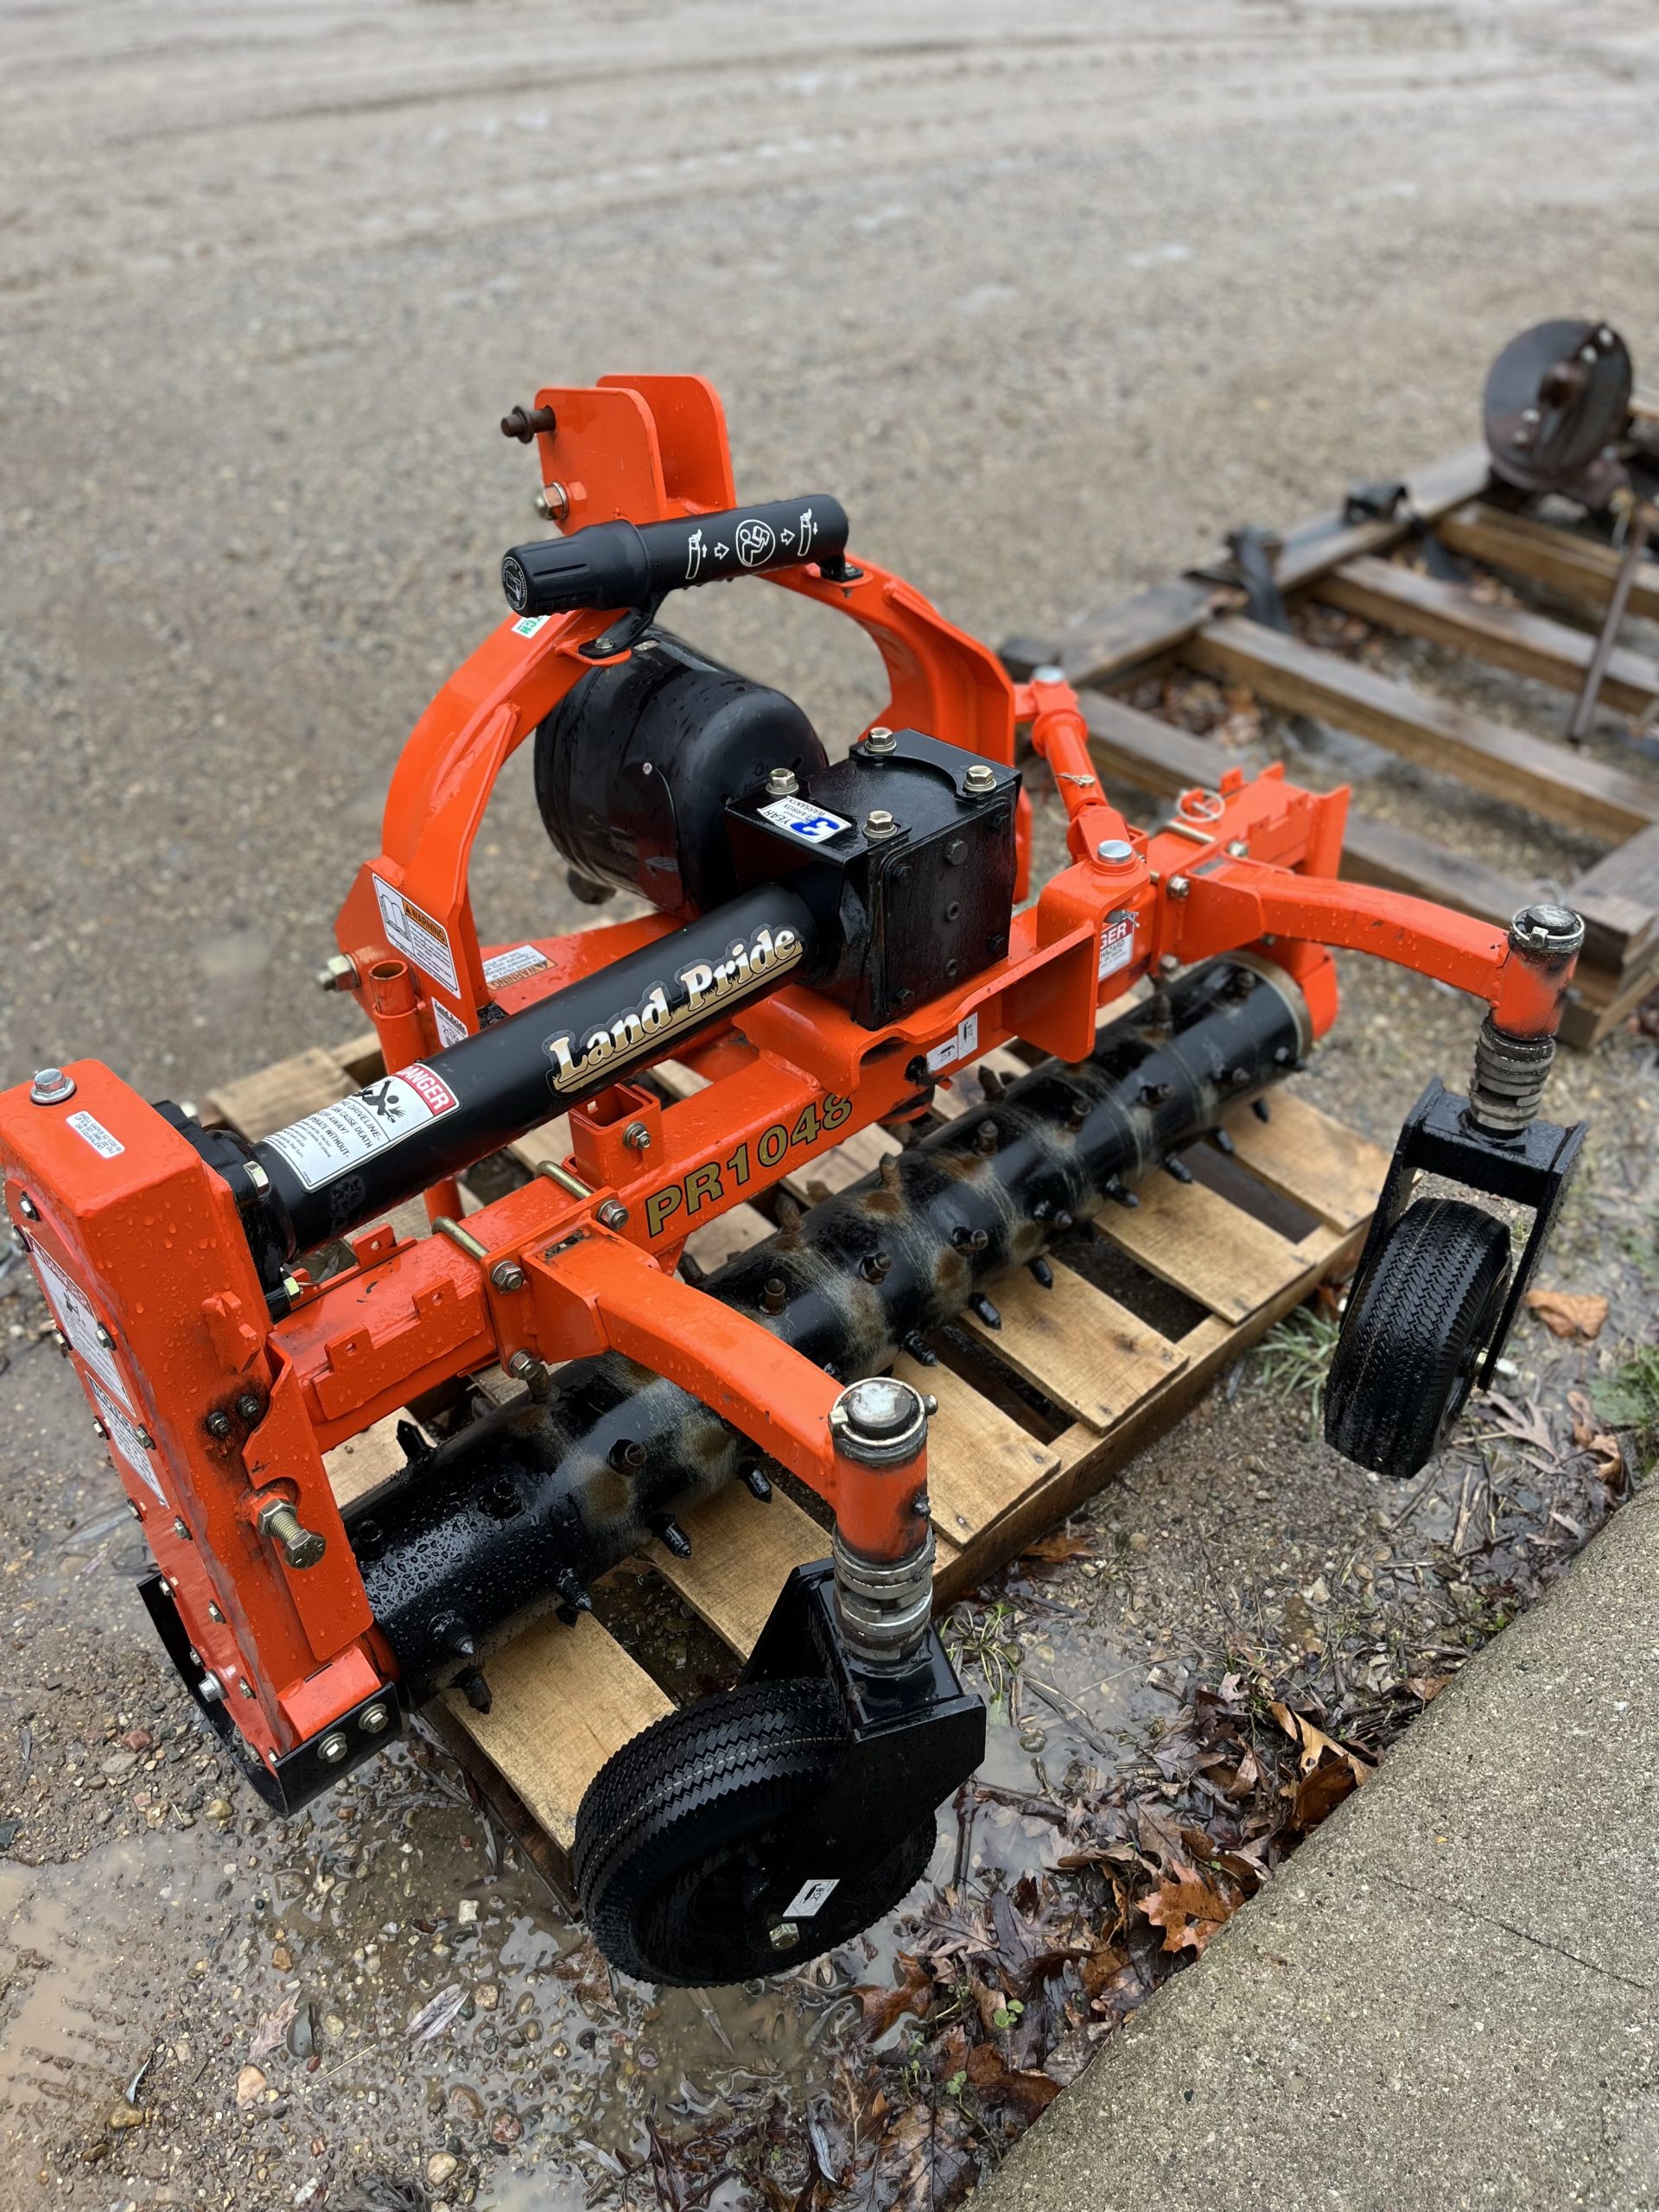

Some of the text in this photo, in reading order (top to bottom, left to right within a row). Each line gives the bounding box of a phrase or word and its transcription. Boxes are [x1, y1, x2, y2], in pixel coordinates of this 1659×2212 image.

[783, 804, 817, 821] GEARBOX
[788, 798, 824, 817] WARRANTY
[765, 810, 840, 836] 3 YEAR
[413, 909, 445, 941] WARNING
[1100, 922, 1126, 950] GER
[491, 966, 540, 988] WARNING
[550, 928, 802, 1084] Land Pride
[400, 1065, 449, 1111] DANGER
[339, 1109, 356, 1126] CAUSE
[356, 1122, 372, 1148] DEATH
[645, 1093, 853, 1237] PR1048
